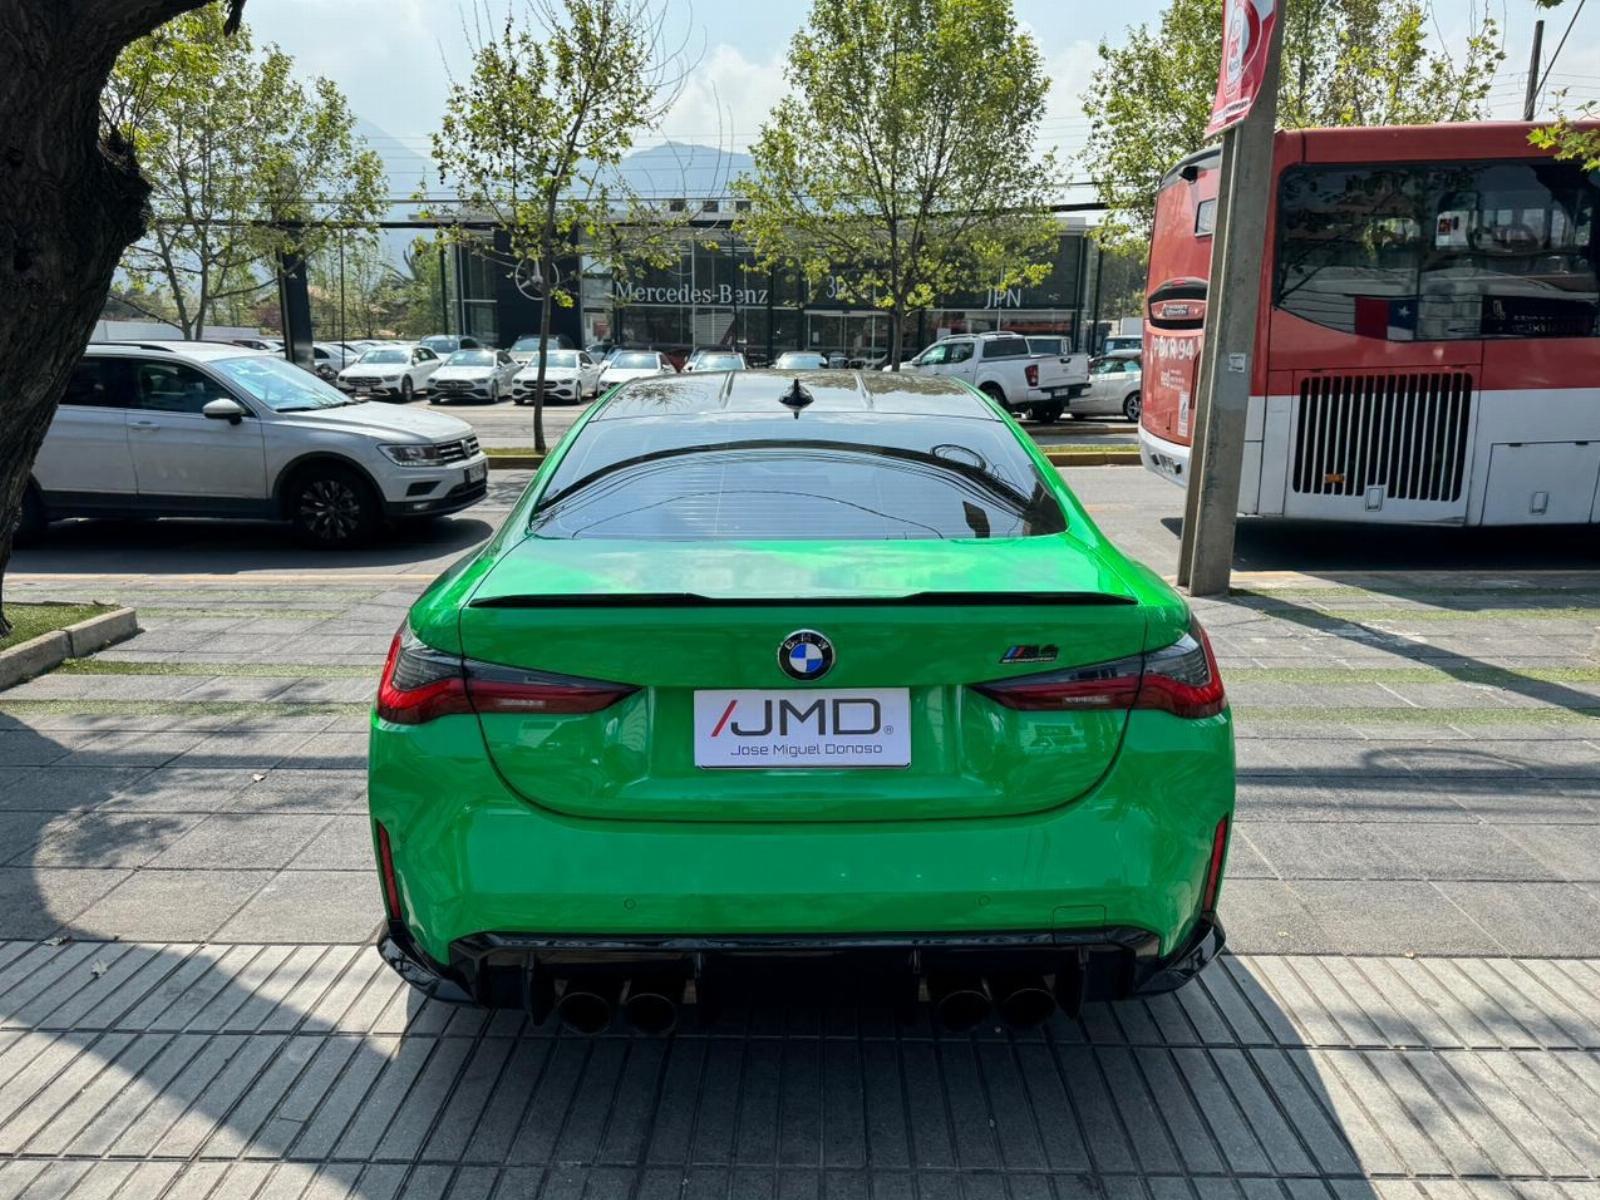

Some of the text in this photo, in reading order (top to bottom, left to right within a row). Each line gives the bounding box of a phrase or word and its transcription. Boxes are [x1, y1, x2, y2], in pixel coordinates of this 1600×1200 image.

[615, 281, 769, 305] Mercedes-Benz
[731, 743, 883, 757] Jose Miguel Donoso
